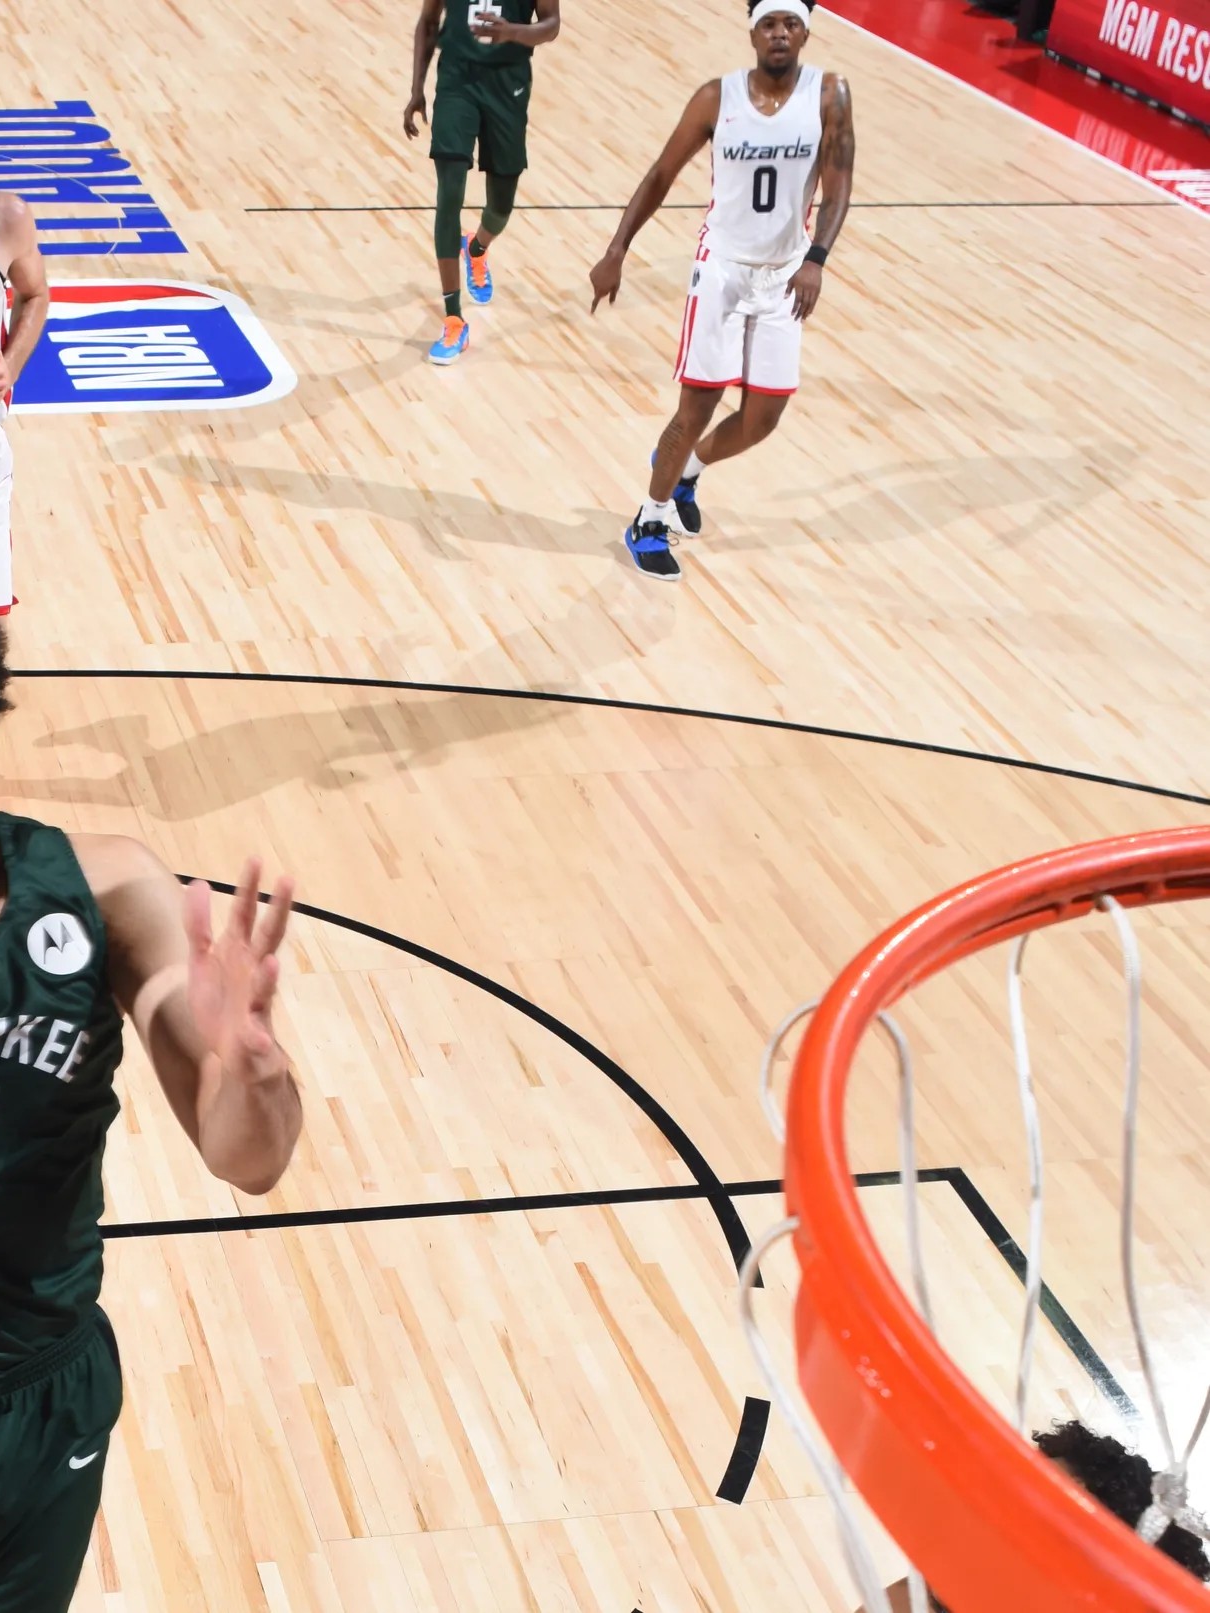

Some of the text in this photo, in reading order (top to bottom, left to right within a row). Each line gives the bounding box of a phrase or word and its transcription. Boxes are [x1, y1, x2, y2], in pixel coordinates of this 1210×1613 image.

[1099, 0, 1160, 61] MGM
[722, 136, 813, 161] wizards
[752, 165, 778, 214] 0
[47, 324, 225, 390] NBA
